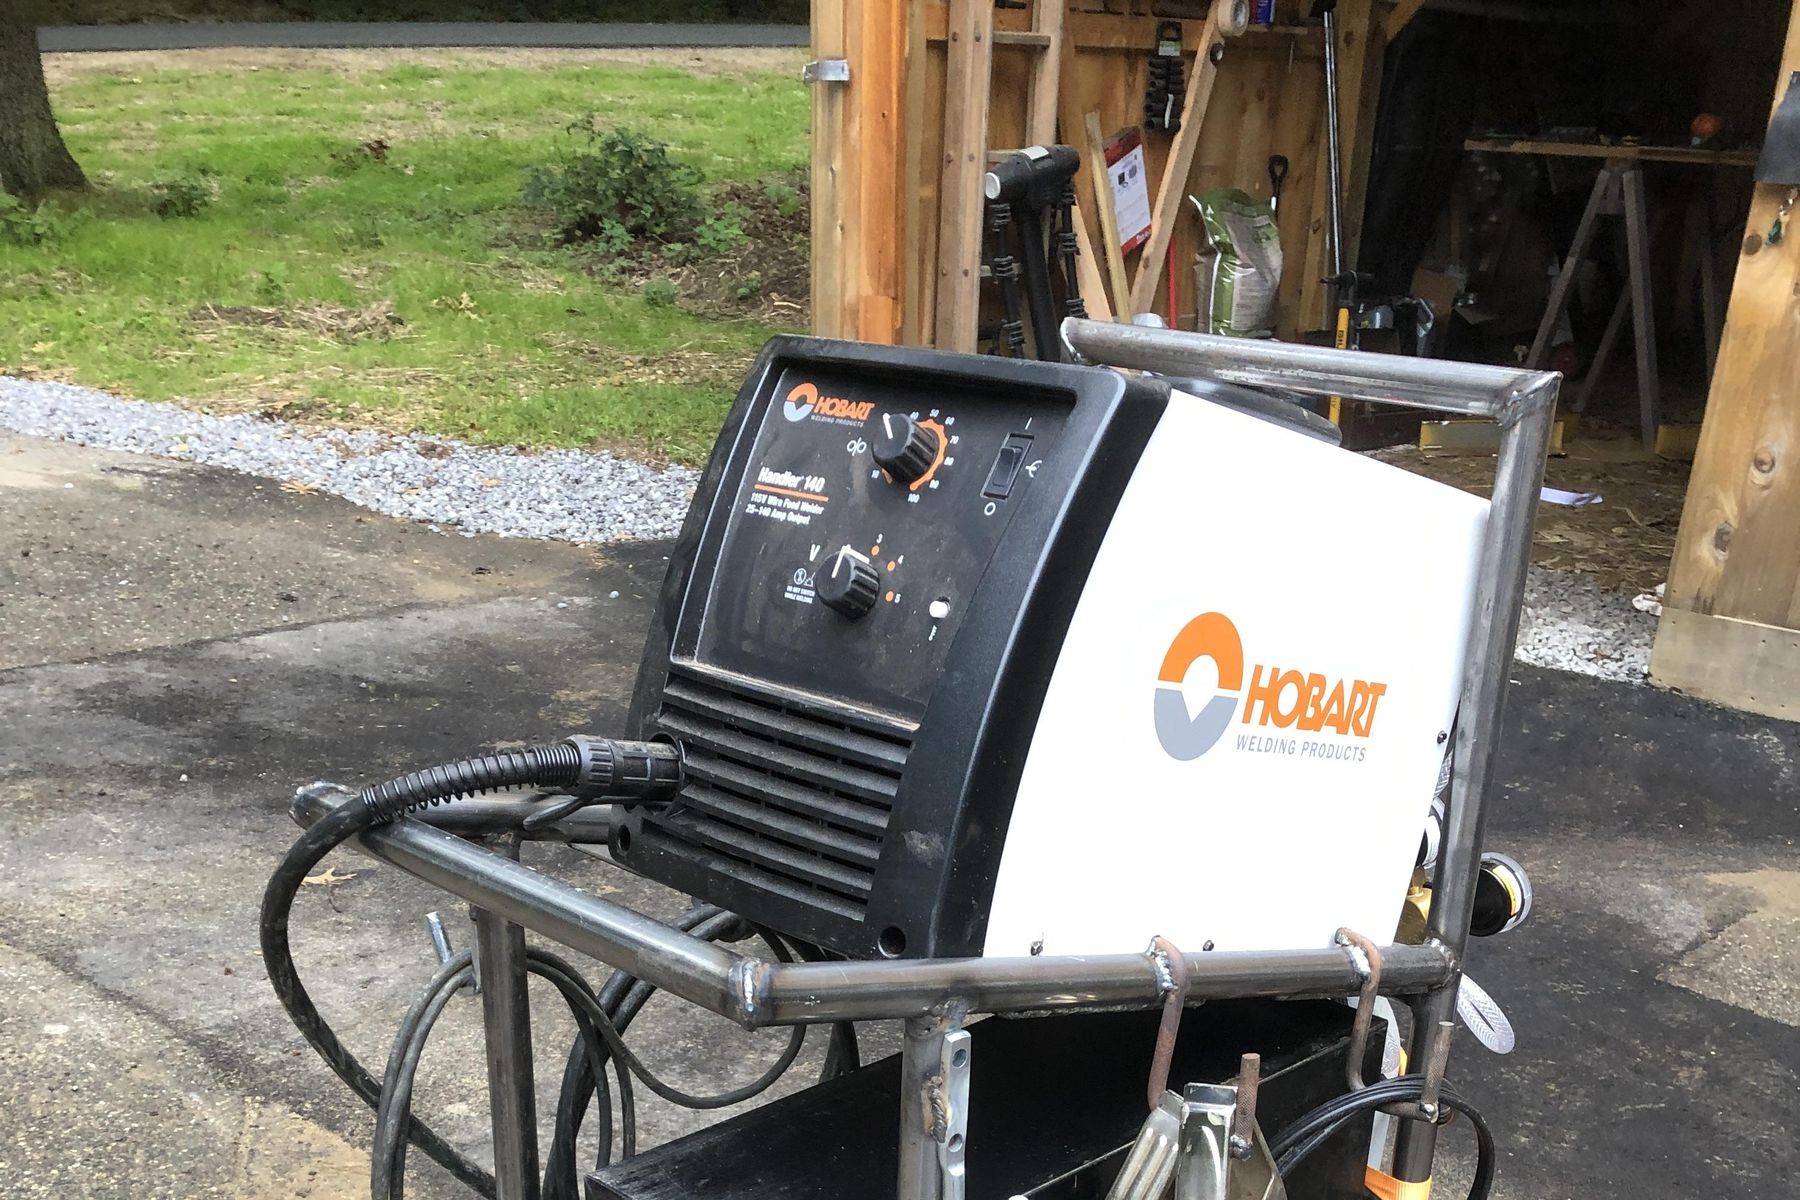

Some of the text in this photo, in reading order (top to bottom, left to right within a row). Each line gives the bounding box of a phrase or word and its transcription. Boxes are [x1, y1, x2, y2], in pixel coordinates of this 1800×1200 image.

[814, 396, 875, 420] HOBART
[929, 409, 939, 418] 50
[811, 414, 864, 428] WELDING PRODUCTS
[945, 416, 955, 426] 60
[950, 435, 959, 444] 70
[758, 466, 825, 492] Handler 140
[871, 469, 880, 479] 10
[750, 492, 825, 515] 115V Wire Feed Welder
[907, 493, 920, 503] 100
[770, 508, 787, 521] Amp
[787, 511, 811, 525] Output
[876, 533, 883, 544] 3
[809, 543, 820, 561] V
[897, 554, 904, 564] 4
[894, 593, 901, 604] 5
[1242, 664, 1387, 737] HOBART
[1236, 734, 1366, 762] WELDING PRODUCTS
